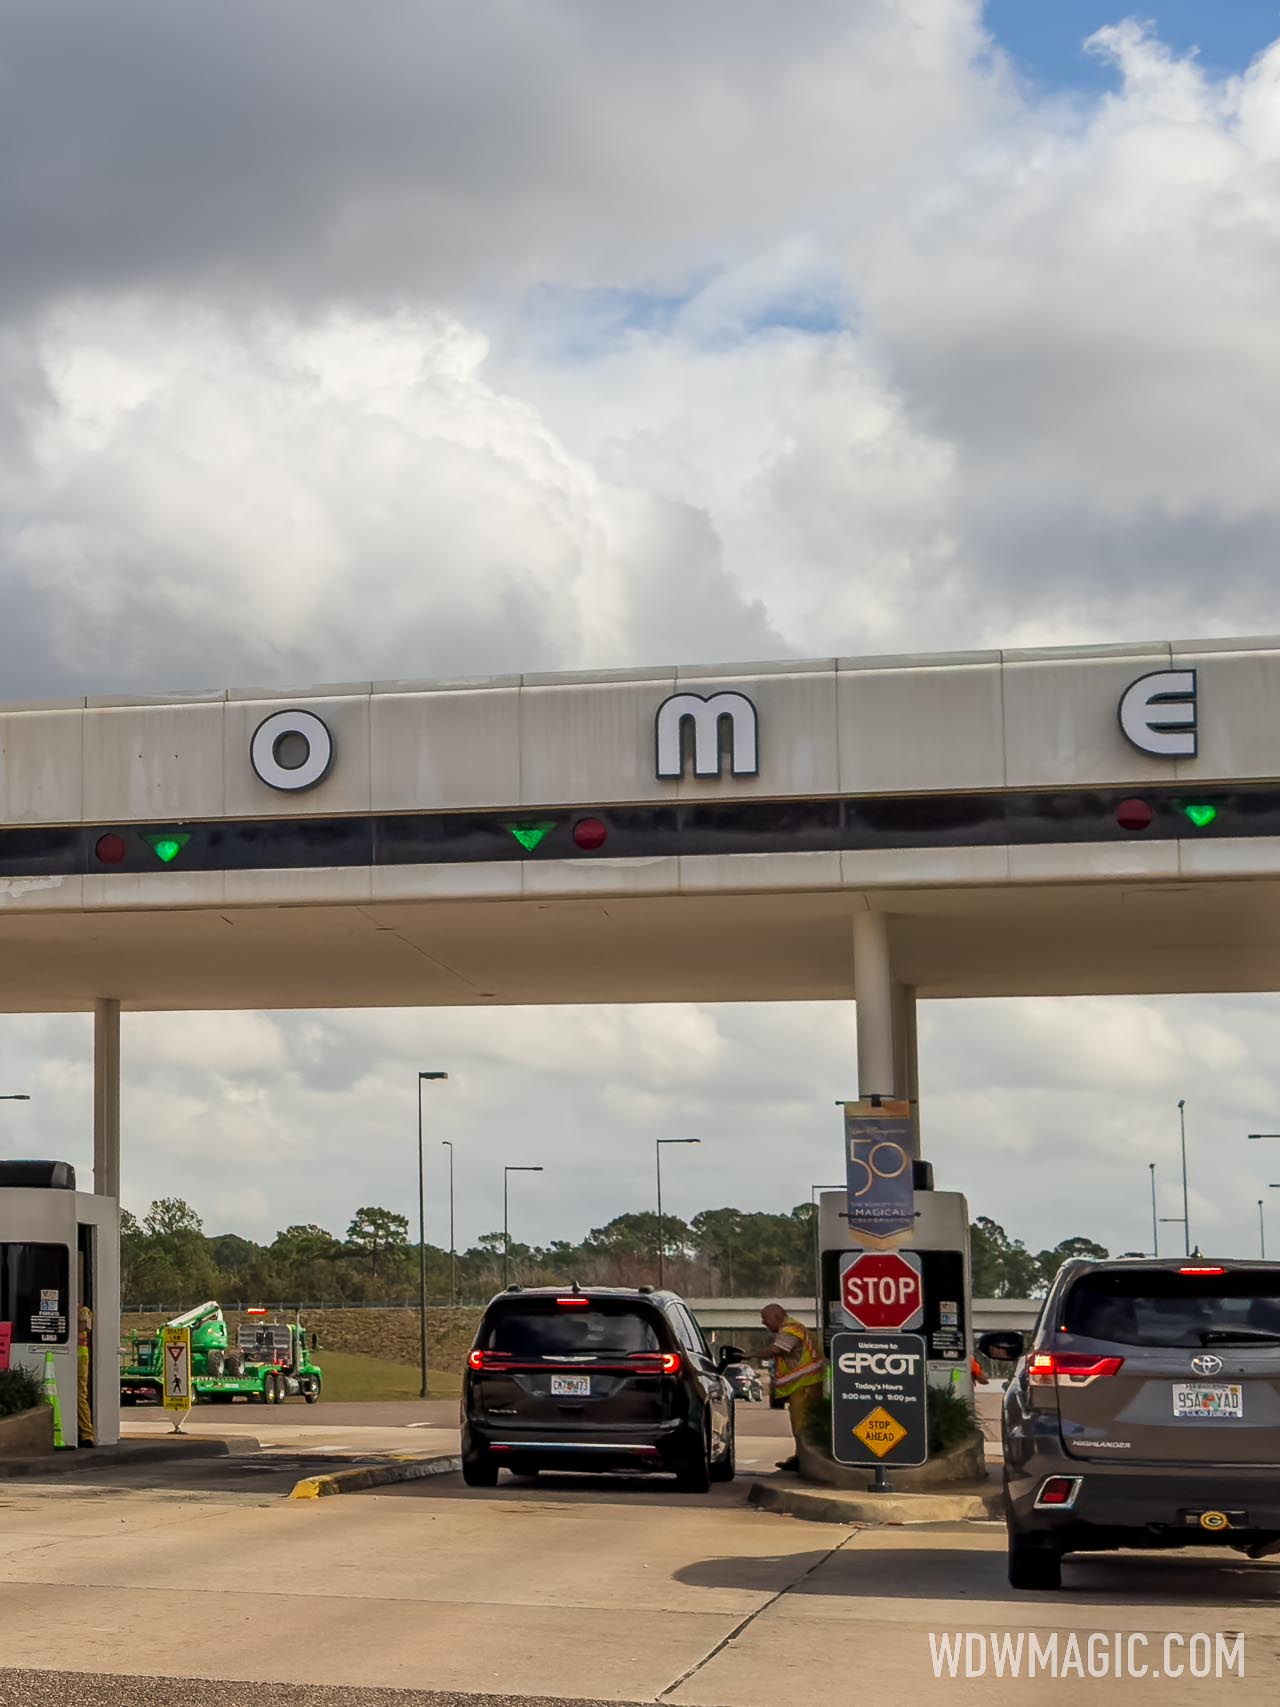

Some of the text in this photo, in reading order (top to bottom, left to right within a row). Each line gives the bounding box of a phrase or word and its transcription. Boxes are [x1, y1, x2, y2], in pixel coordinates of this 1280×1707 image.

[851, 1139, 907, 1196] 50
[855, 1208, 905, 1216] MAGICAL
[847, 1276, 915, 1305] STOP
[838, 1352, 920, 1375] EPCOT
[854, 1382, 881, 1391] Today's
[841, 1392, 858, 1400] 9:00
[1178, 1392, 1201, 1408] 95A
[868, 1420, 891, 1430] STOP
[865, 1432, 894, 1441] AHEAD
[1071, 1440, 1131, 1448] HIGHLANDER
